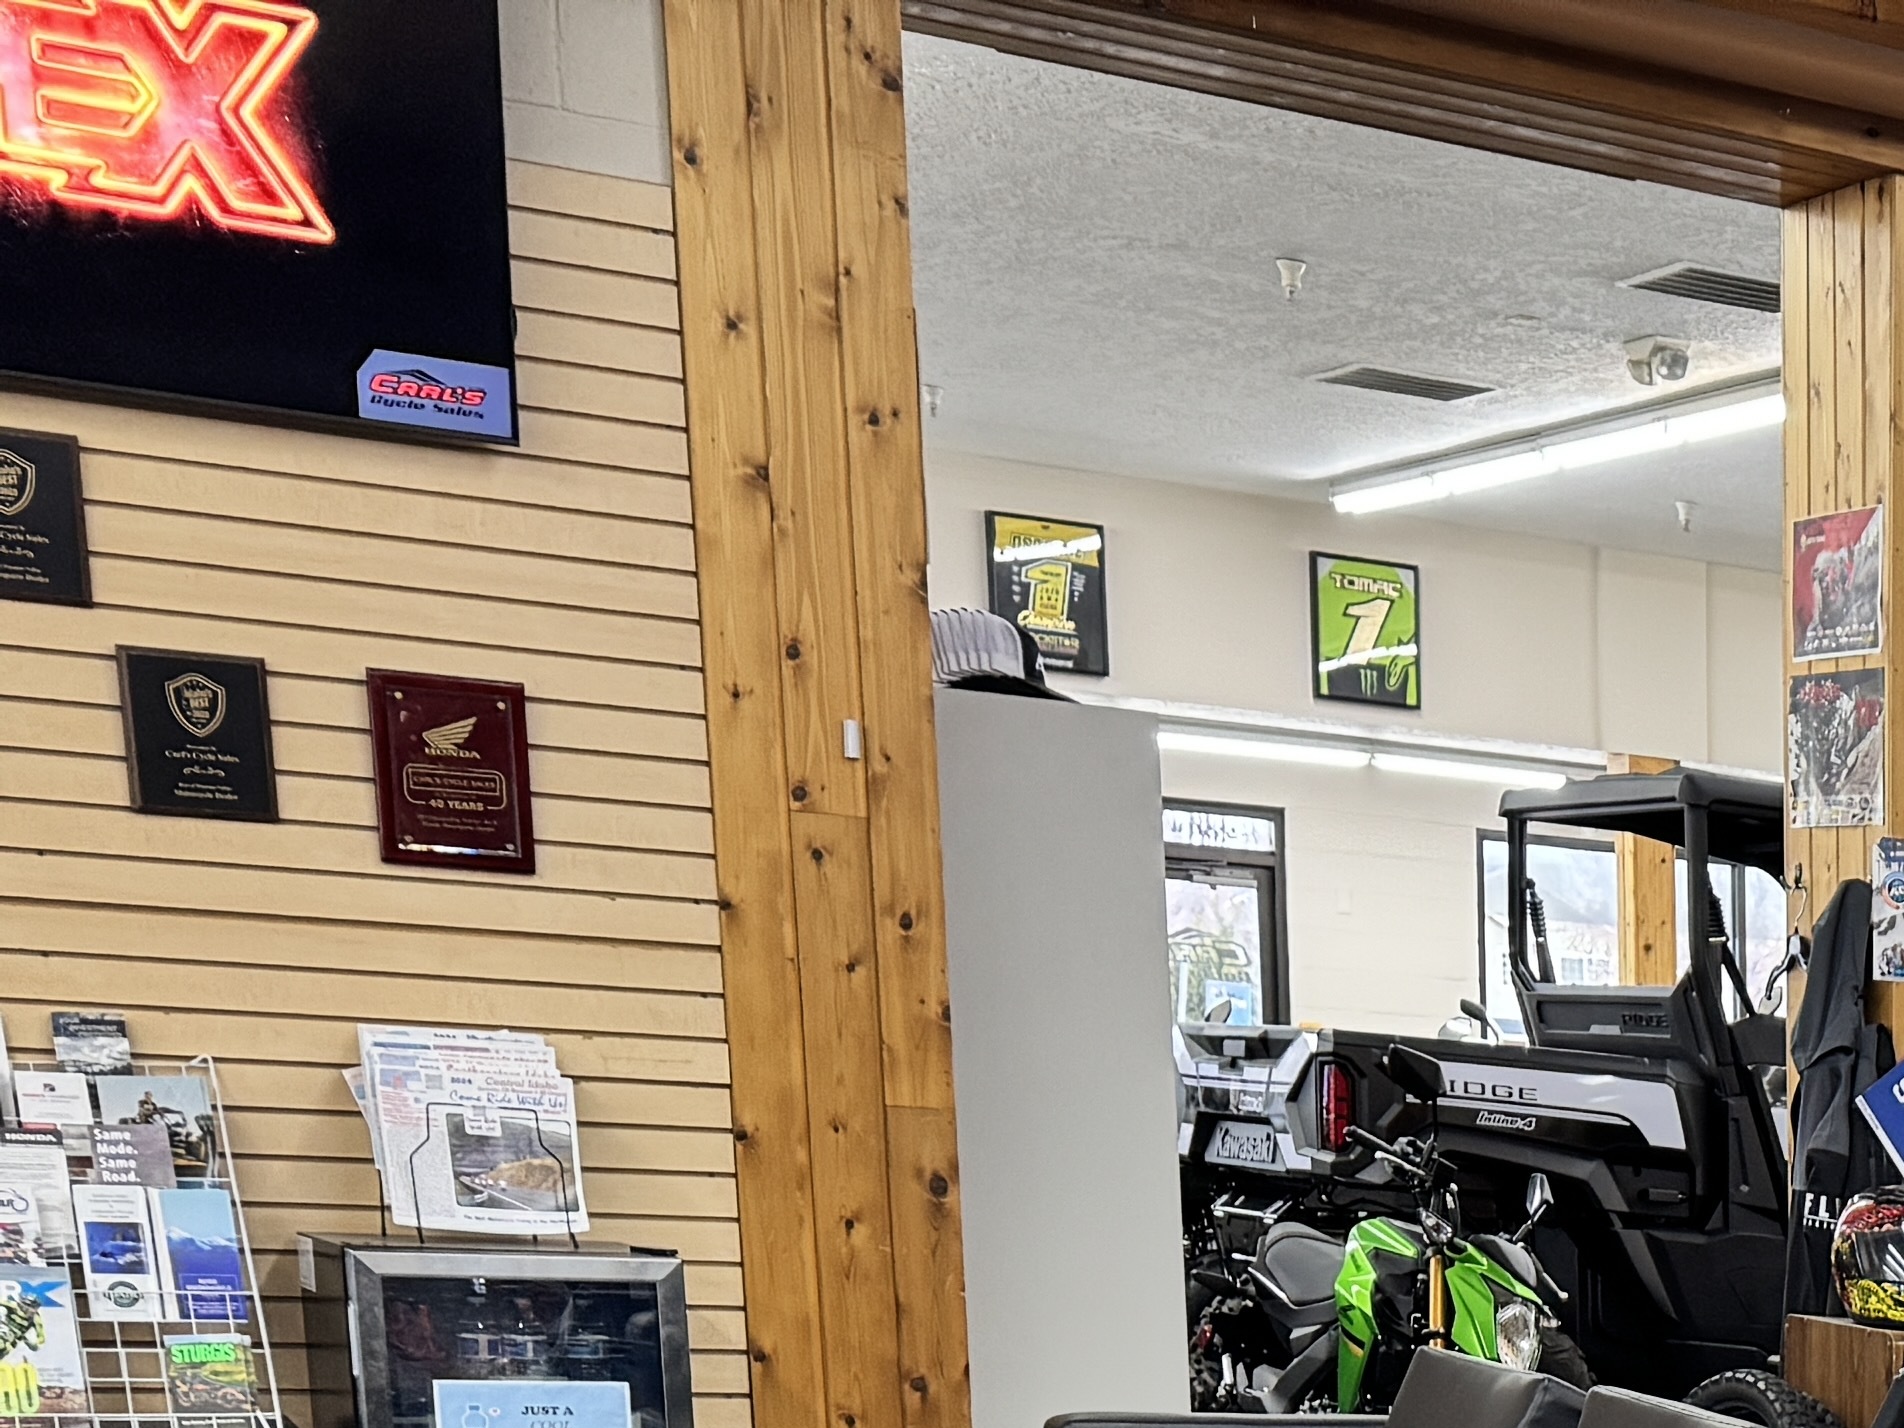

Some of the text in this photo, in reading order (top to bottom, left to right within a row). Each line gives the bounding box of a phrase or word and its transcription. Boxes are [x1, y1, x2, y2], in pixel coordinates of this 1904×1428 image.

[369, 373, 488, 407] CARL'S
[1330, 573, 1402, 598] TOMAC
[1345, 597, 1395, 666] 1
[424, 746, 481, 760] HONDA
[447, 800, 484, 812] YEARS
[1449, 1078, 1538, 1102] IDGE
[93, 1128, 131, 1141] Same
[96, 1142, 139, 1155] Mode.
[1215, 1126, 1276, 1163] Kawasaki
[98, 1156, 137, 1169] Same
[102, 1170, 141, 1183] Road.
[171, 1341, 237, 1364] STURGIS
[521, 1406, 574, 1416] JUST A
